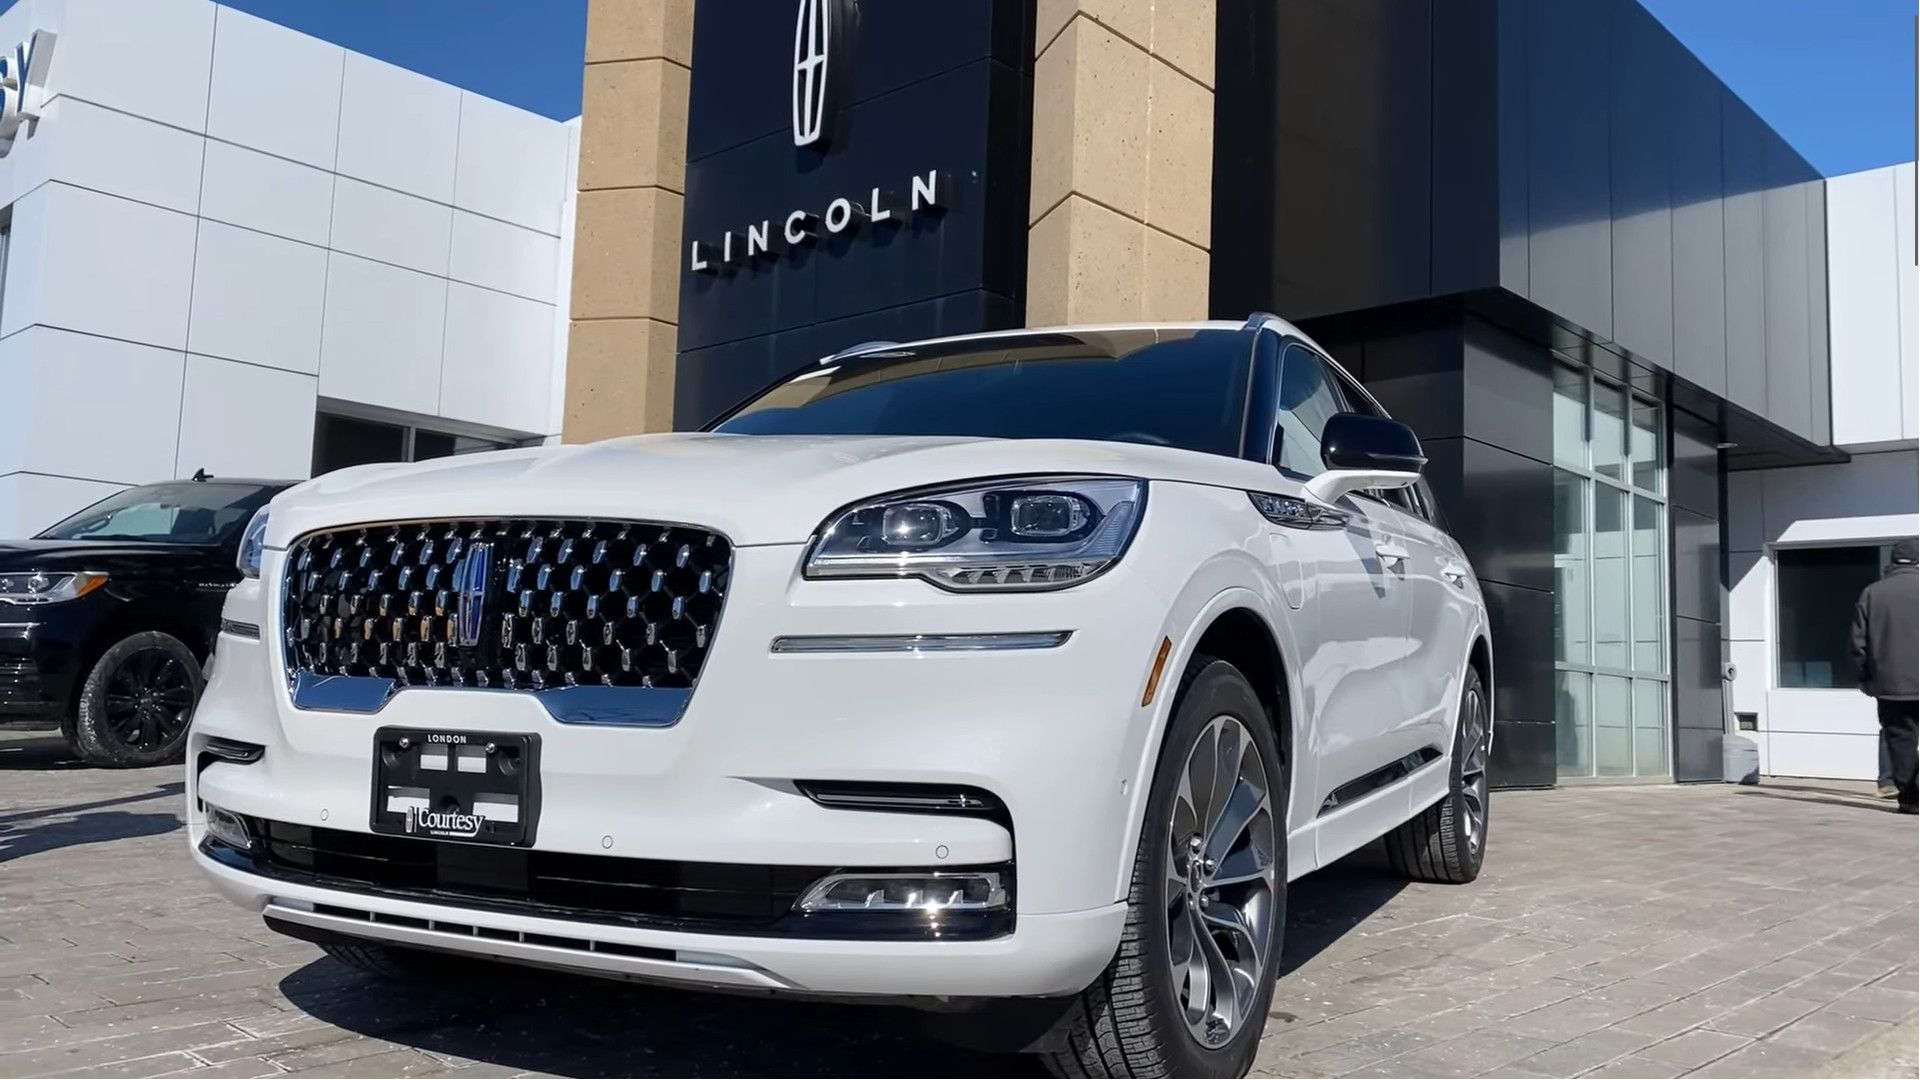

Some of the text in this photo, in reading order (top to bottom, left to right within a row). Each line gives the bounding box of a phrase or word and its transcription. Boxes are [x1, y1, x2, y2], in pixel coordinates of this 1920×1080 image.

[691, 169, 937, 271] LINCOLN
[427, 734, 468, 744] LONDON
[418, 809, 484, 837] Courtesy
